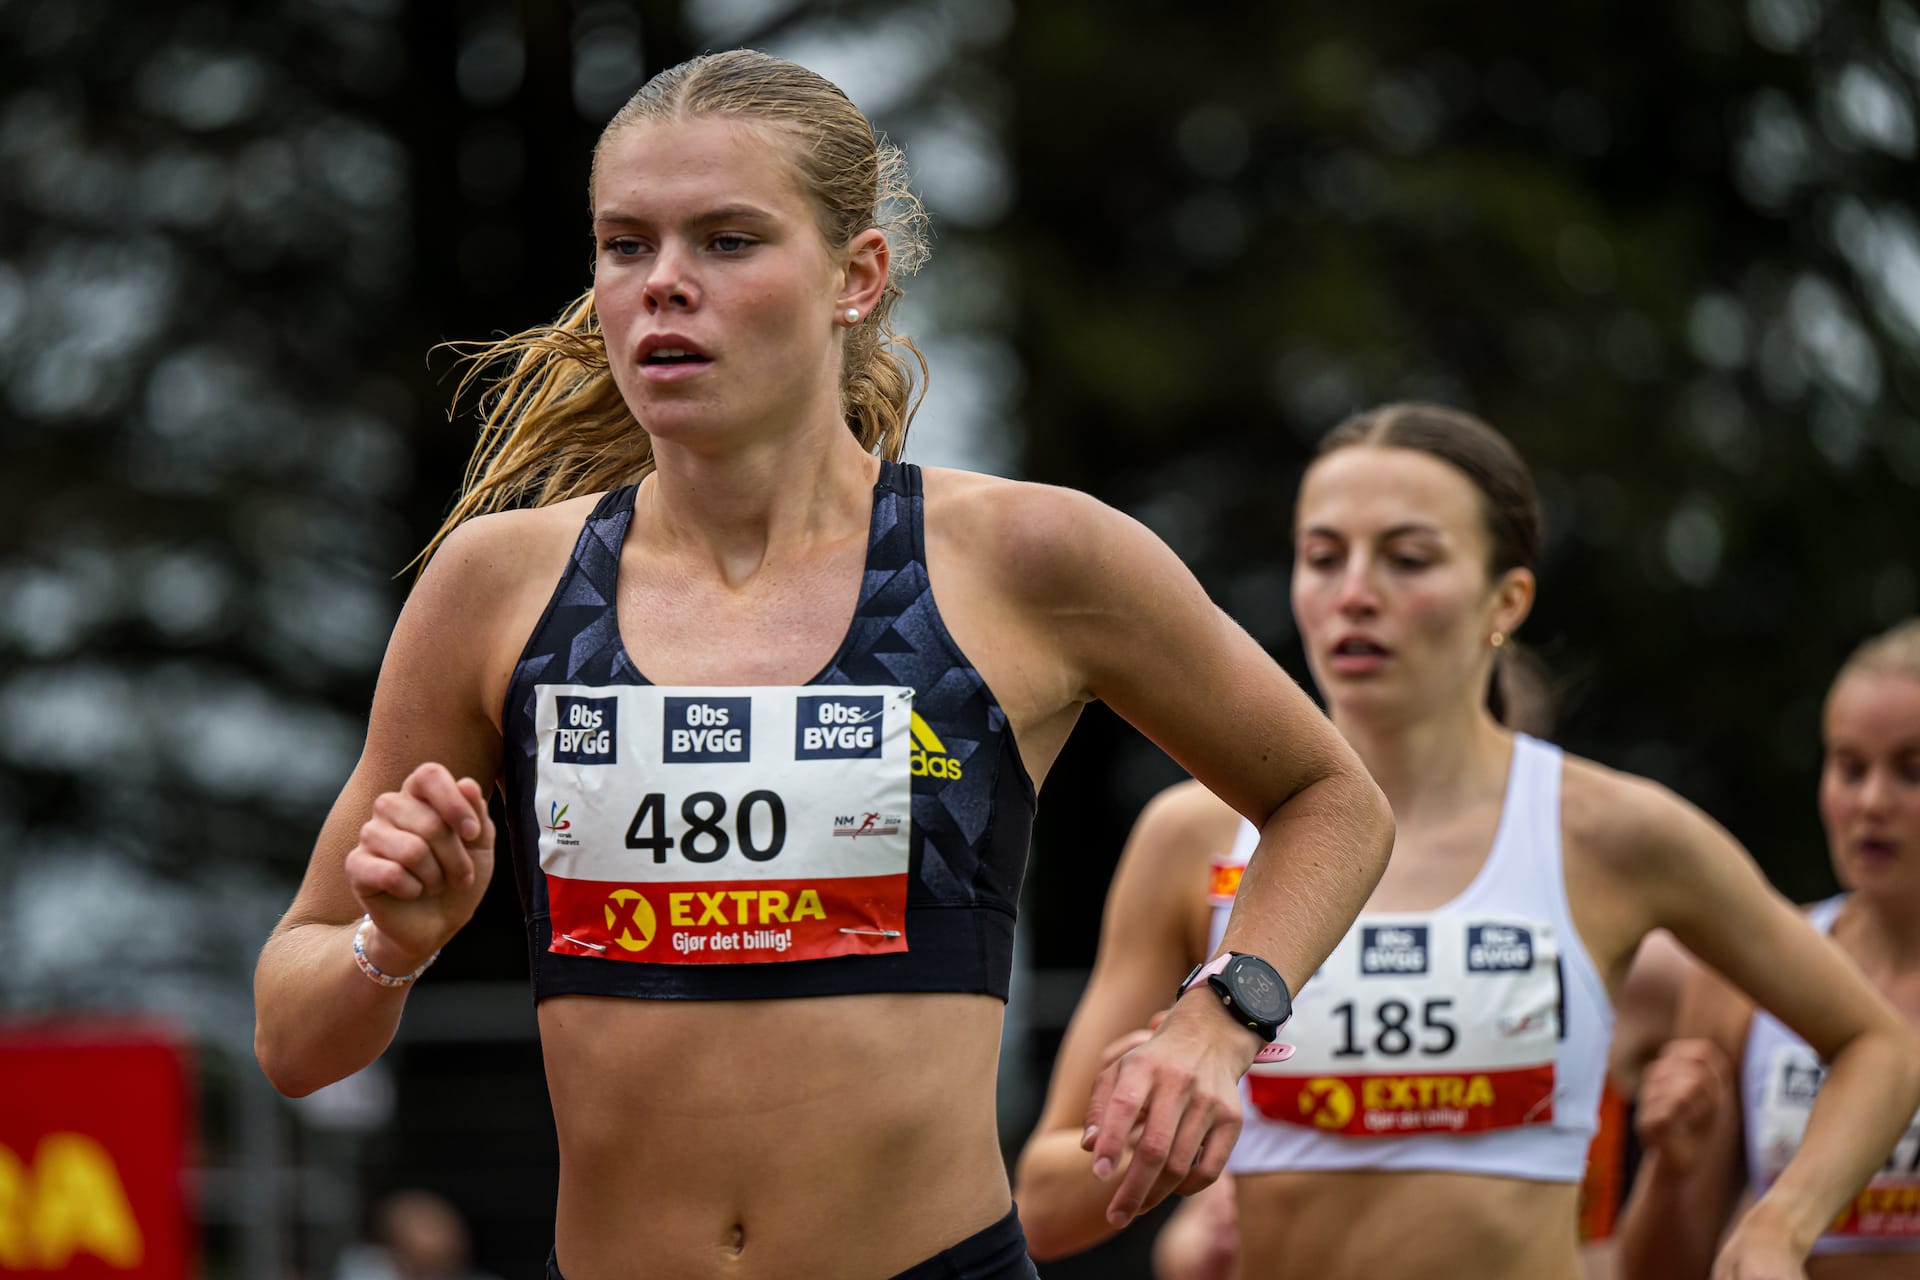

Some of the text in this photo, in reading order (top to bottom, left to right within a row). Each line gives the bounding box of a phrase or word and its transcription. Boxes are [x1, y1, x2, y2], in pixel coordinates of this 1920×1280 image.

[559, 730, 610, 754] BYGG
[671, 728, 742, 753] BYGG
[803, 726, 874, 750] BYGG
[625, 789, 787, 863] 480
[834, 816, 855, 826] NM
[669, 889, 827, 926] EXTRA
[672, 928, 792, 955] Gjør det billig!
[1332, 1000, 1456, 1058] 185
[1363, 1076, 1494, 1108] EXTRA
